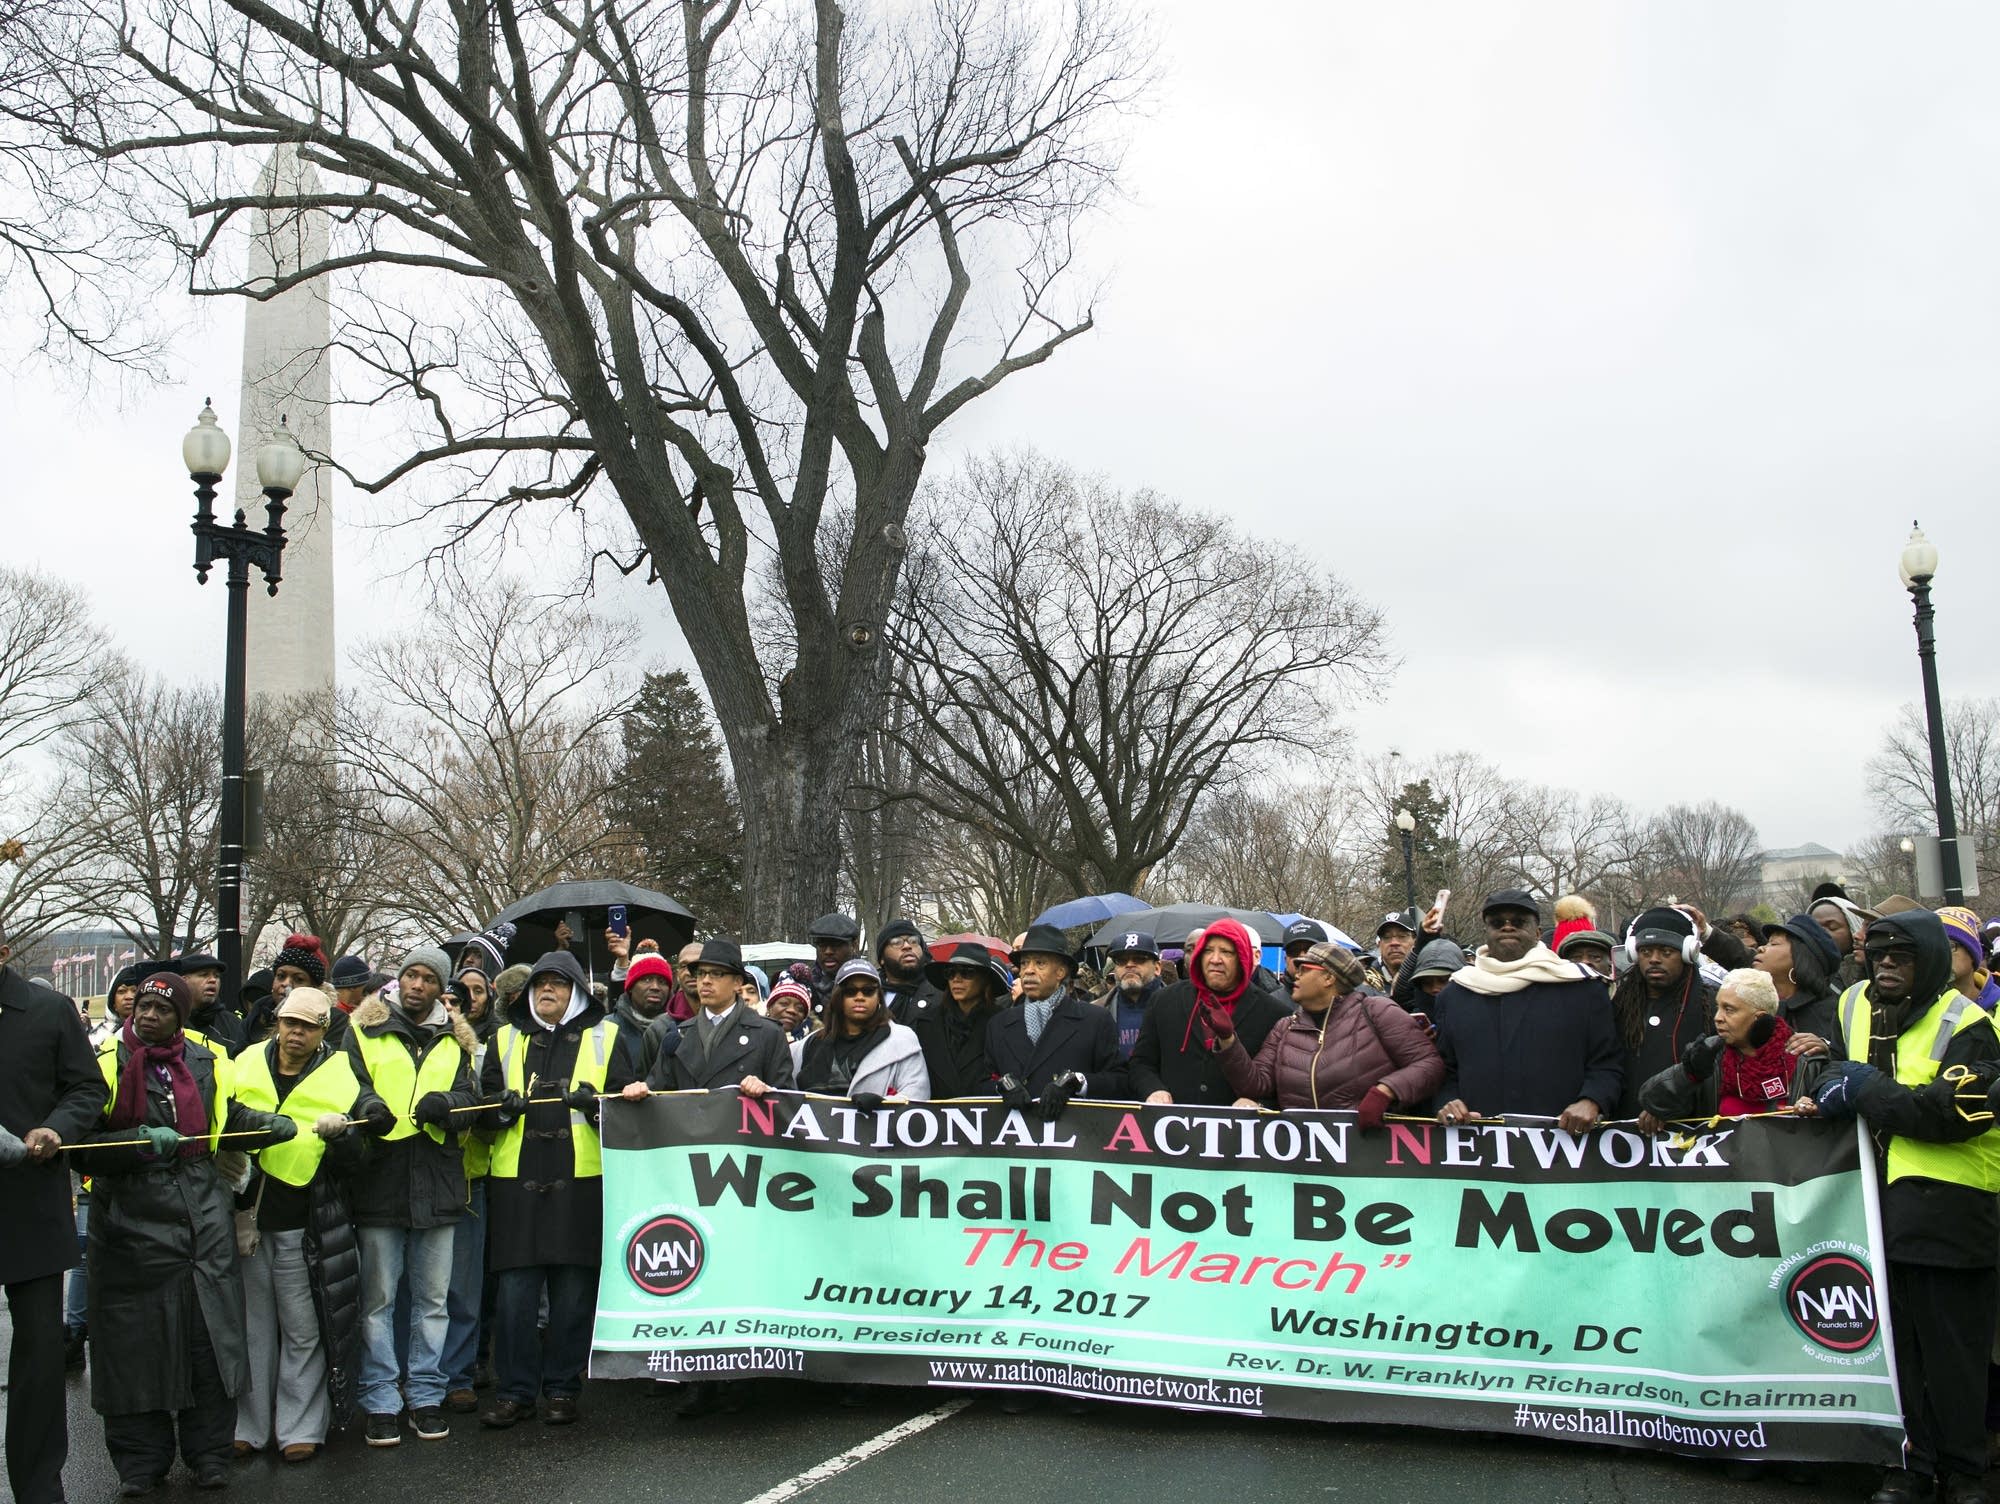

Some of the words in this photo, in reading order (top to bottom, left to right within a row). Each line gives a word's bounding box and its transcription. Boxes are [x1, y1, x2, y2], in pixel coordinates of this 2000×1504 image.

[140, 982, 173, 997] Jesus
[738, 1097, 1077, 1148] NATIONAL
[1104, 1113, 1353, 1164] ACTION
[1386, 1124, 1735, 1168] NETWORK
[688, 1153, 816, 1212] We
[852, 1165, 1052, 1222] Shall
[1090, 1171, 1253, 1238] Not
[1293, 1182, 1415, 1246] Be
[1455, 1188, 1782, 1258] Moved
[634, 1239, 696, 1272] NAN
[962, 1227, 1089, 1271] The
[1768, 1252, 1806, 1290] NATIONAL
[1806, 1240, 1846, 1256] ACTION
[804, 1277, 972, 1314] January
[984, 1285, 1043, 1315] 14,
[1053, 1288, 1151, 1319] 2017
[1796, 1285, 1874, 1320] NAN
[632, 1323, 688, 1338] Rev.
[696, 1319, 726, 1336] Al
[735, 1319, 844, 1342] Sharpton,
[853, 1326, 983, 1346] President
[991, 1331, 1008, 1346] &
[1018, 1332, 1114, 1356] Founder
[1270, 1306, 1554, 1355] Washington,
[1574, 1325, 1642, 1354] DC
[1817, 1321, 1848, 1329] Founded
[1849, 1321, 1863, 1329] 1991
[647, 1347, 805, 1373] #themarch2017
[1801, 1344, 1815, 1356] NO
[1815, 1351, 1852, 1366] JUSTICE
[1854, 1356, 1866, 1365] NO
[1865, 1344, 1882, 1362] PEAC
[930, 1360, 1263, 1406] www.nationalactionnetwork.net
[1227, 1352, 1284, 1372] Rev.
[1295, 1358, 1332, 1376] Dr.
[1344, 1361, 1377, 1380] W.
[1386, 1365, 1514, 1393] Franklyn
[1525, 1375, 1689, 1408] Richardson,
[1700, 1389, 1857, 1407] Chairman
[1514, 1404, 1766, 1448] #weshallnotbemoved
